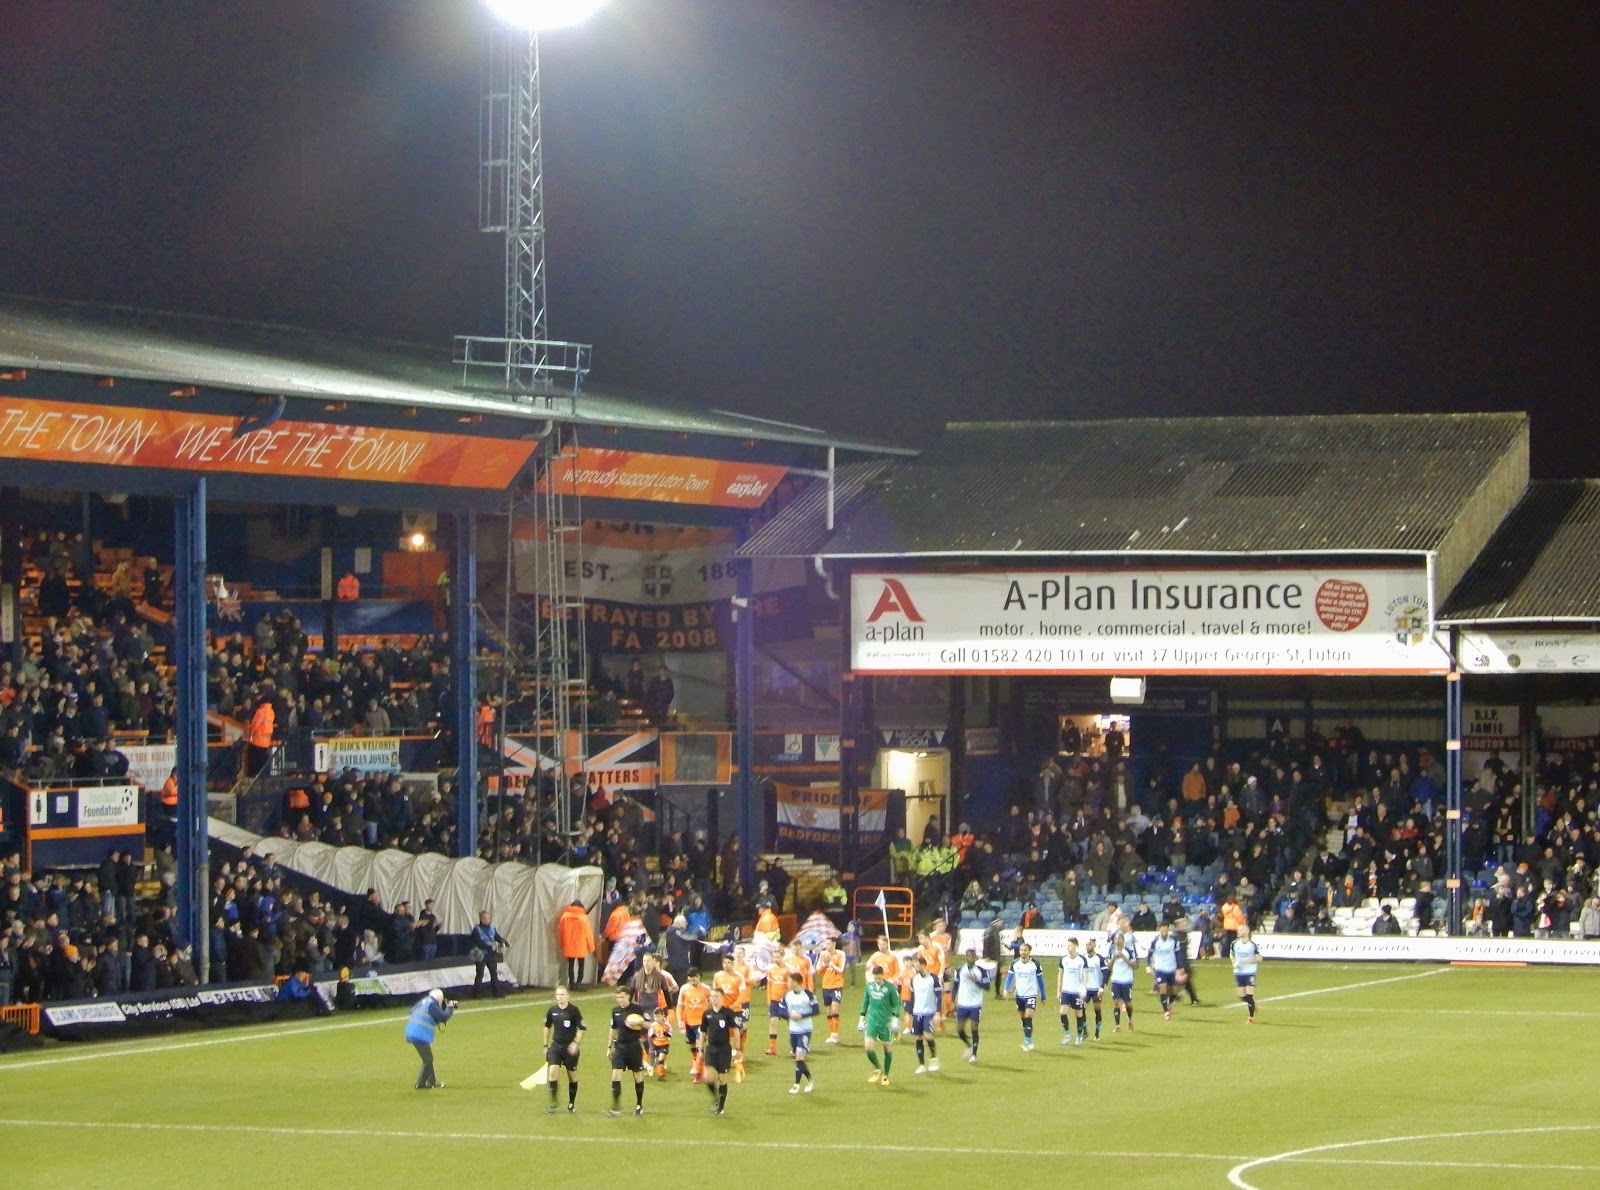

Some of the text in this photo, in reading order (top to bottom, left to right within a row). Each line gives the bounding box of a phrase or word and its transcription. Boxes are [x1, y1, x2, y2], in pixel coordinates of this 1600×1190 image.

[0, 407, 157, 457] THE TOWN
[175, 426, 426, 474] WE ARE THE TOWN!
[575, 467, 618, 488] proudly
[615, 471, 659, 489] support
[653, 471, 685, 489] Luton
[683, 473, 710, 491] Town
[726, 480, 769, 498] easyJet
[699, 561, 738, 582] 188
[1003, 575, 1303, 611] A-Plan Insurance
[683, 607, 716, 627] BY
[865, 622, 924, 645] a-plan
[979, 620, 1312, 636] motor home commercial travel & more!
[611, 629, 718, 649] FA 2008
[940, 648, 967, 663] Call
[971, 649, 1019, 663] 01582
[1024, 649, 1053, 663] 420
[1058, 649, 1085, 663] 101
[1090, 651, 1106, 663] or
[1113, 648, 1146, 663] visit
[1151, 649, 1168, 662] 37
[1174, 649, 1219, 665] Upper
[1225, 649, 1281, 665] George
[1308, 649, 1352, 662] Luton
[586, 769, 641, 786] ATTERS
[83, 804, 123, 818] Foundation
